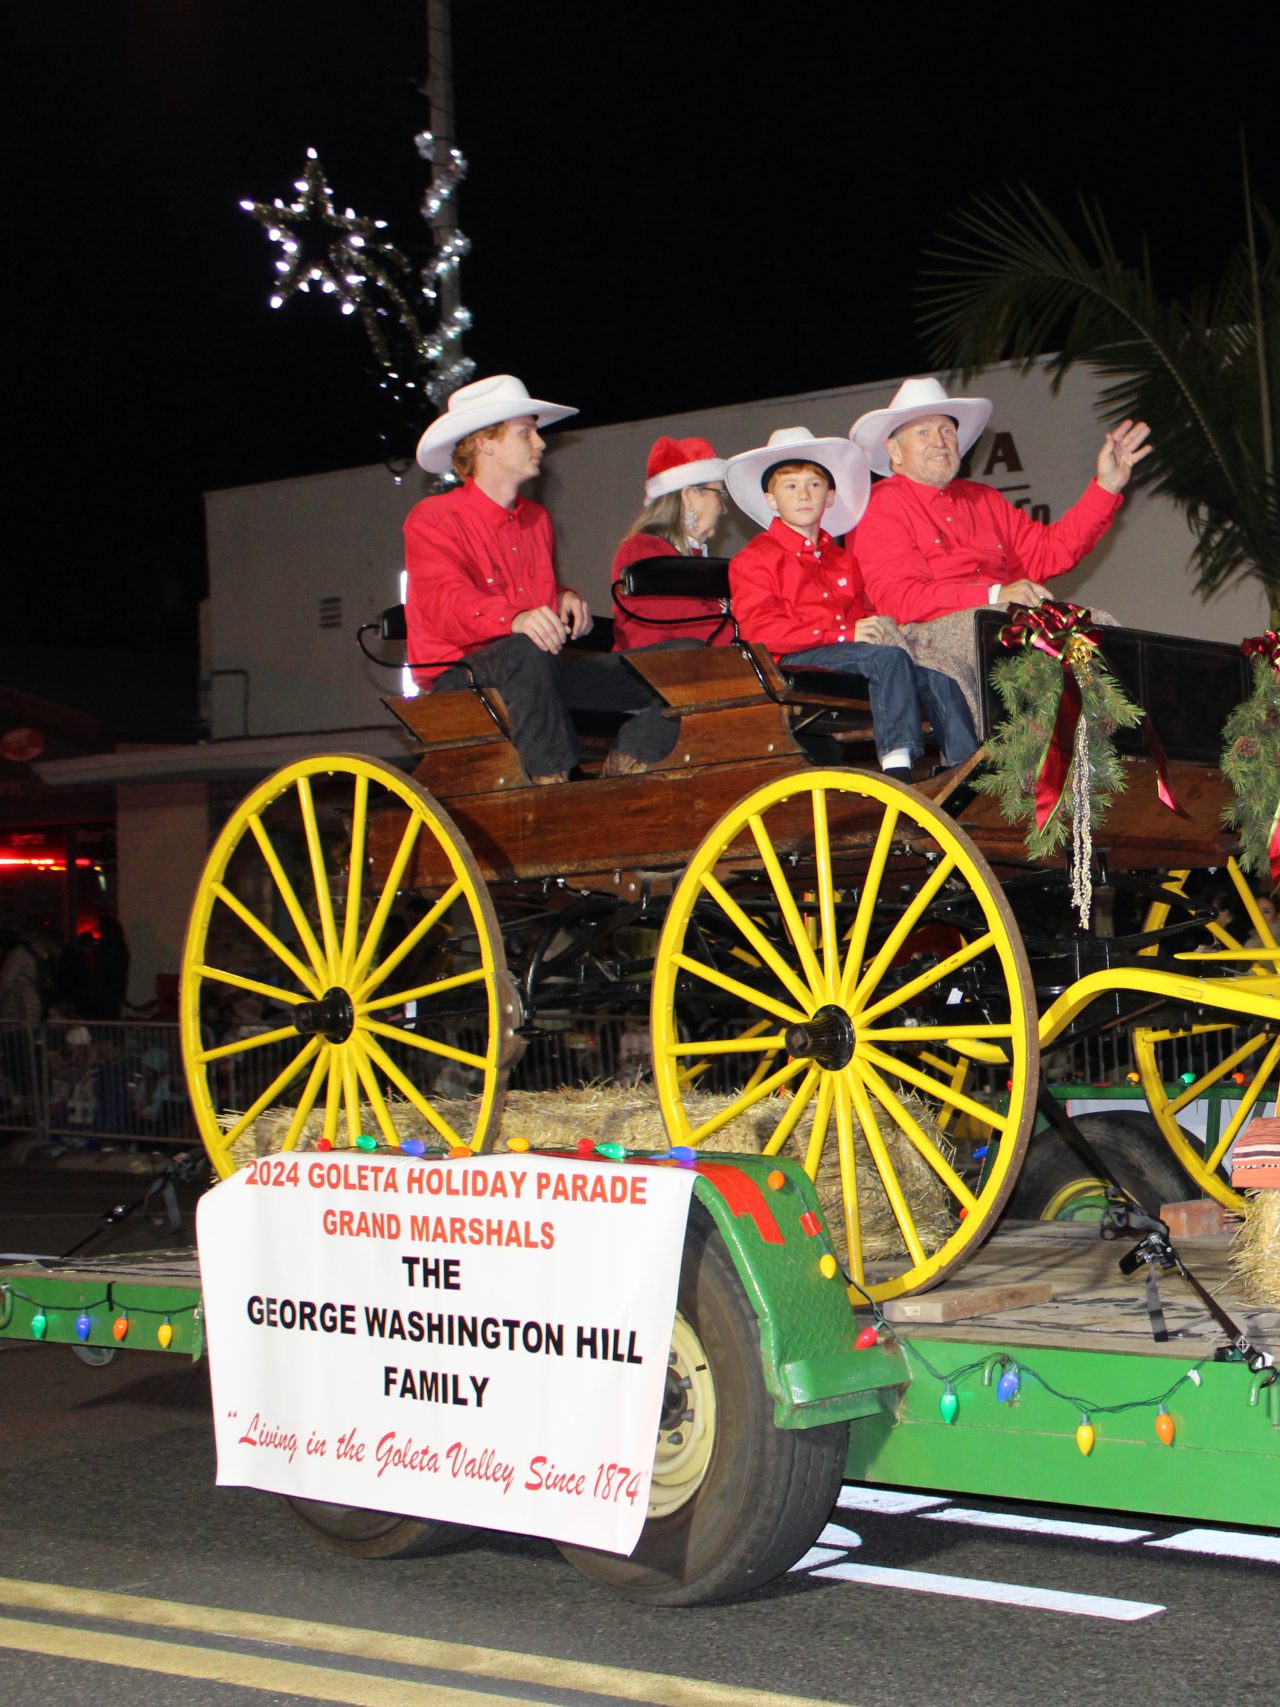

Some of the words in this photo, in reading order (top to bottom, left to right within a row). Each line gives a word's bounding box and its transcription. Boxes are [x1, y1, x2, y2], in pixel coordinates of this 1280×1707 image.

[245, 1160, 299, 1187] 2024
[308, 1162, 398, 1193] GOLETA
[407, 1168, 527, 1198] HOLIDAY
[536, 1172, 648, 1204] PARADE
[323, 1209, 401, 1240] GRAND
[410, 1215, 555, 1249] MARSHALS
[402, 1256, 461, 1290] THE
[247, 1295, 356, 1335] GEORGE
[364, 1306, 564, 1355] WASHINGTON
[576, 1325, 643, 1364] HILL
[384, 1366, 490, 1407] FAMILY
[306, 1430, 327, 1457] in
[336, 1427, 366, 1463] the
[375, 1431, 440, 1478] Goleta
[446, 1441, 515, 1495] Valley
[524, 1455, 586, 1496] Since
